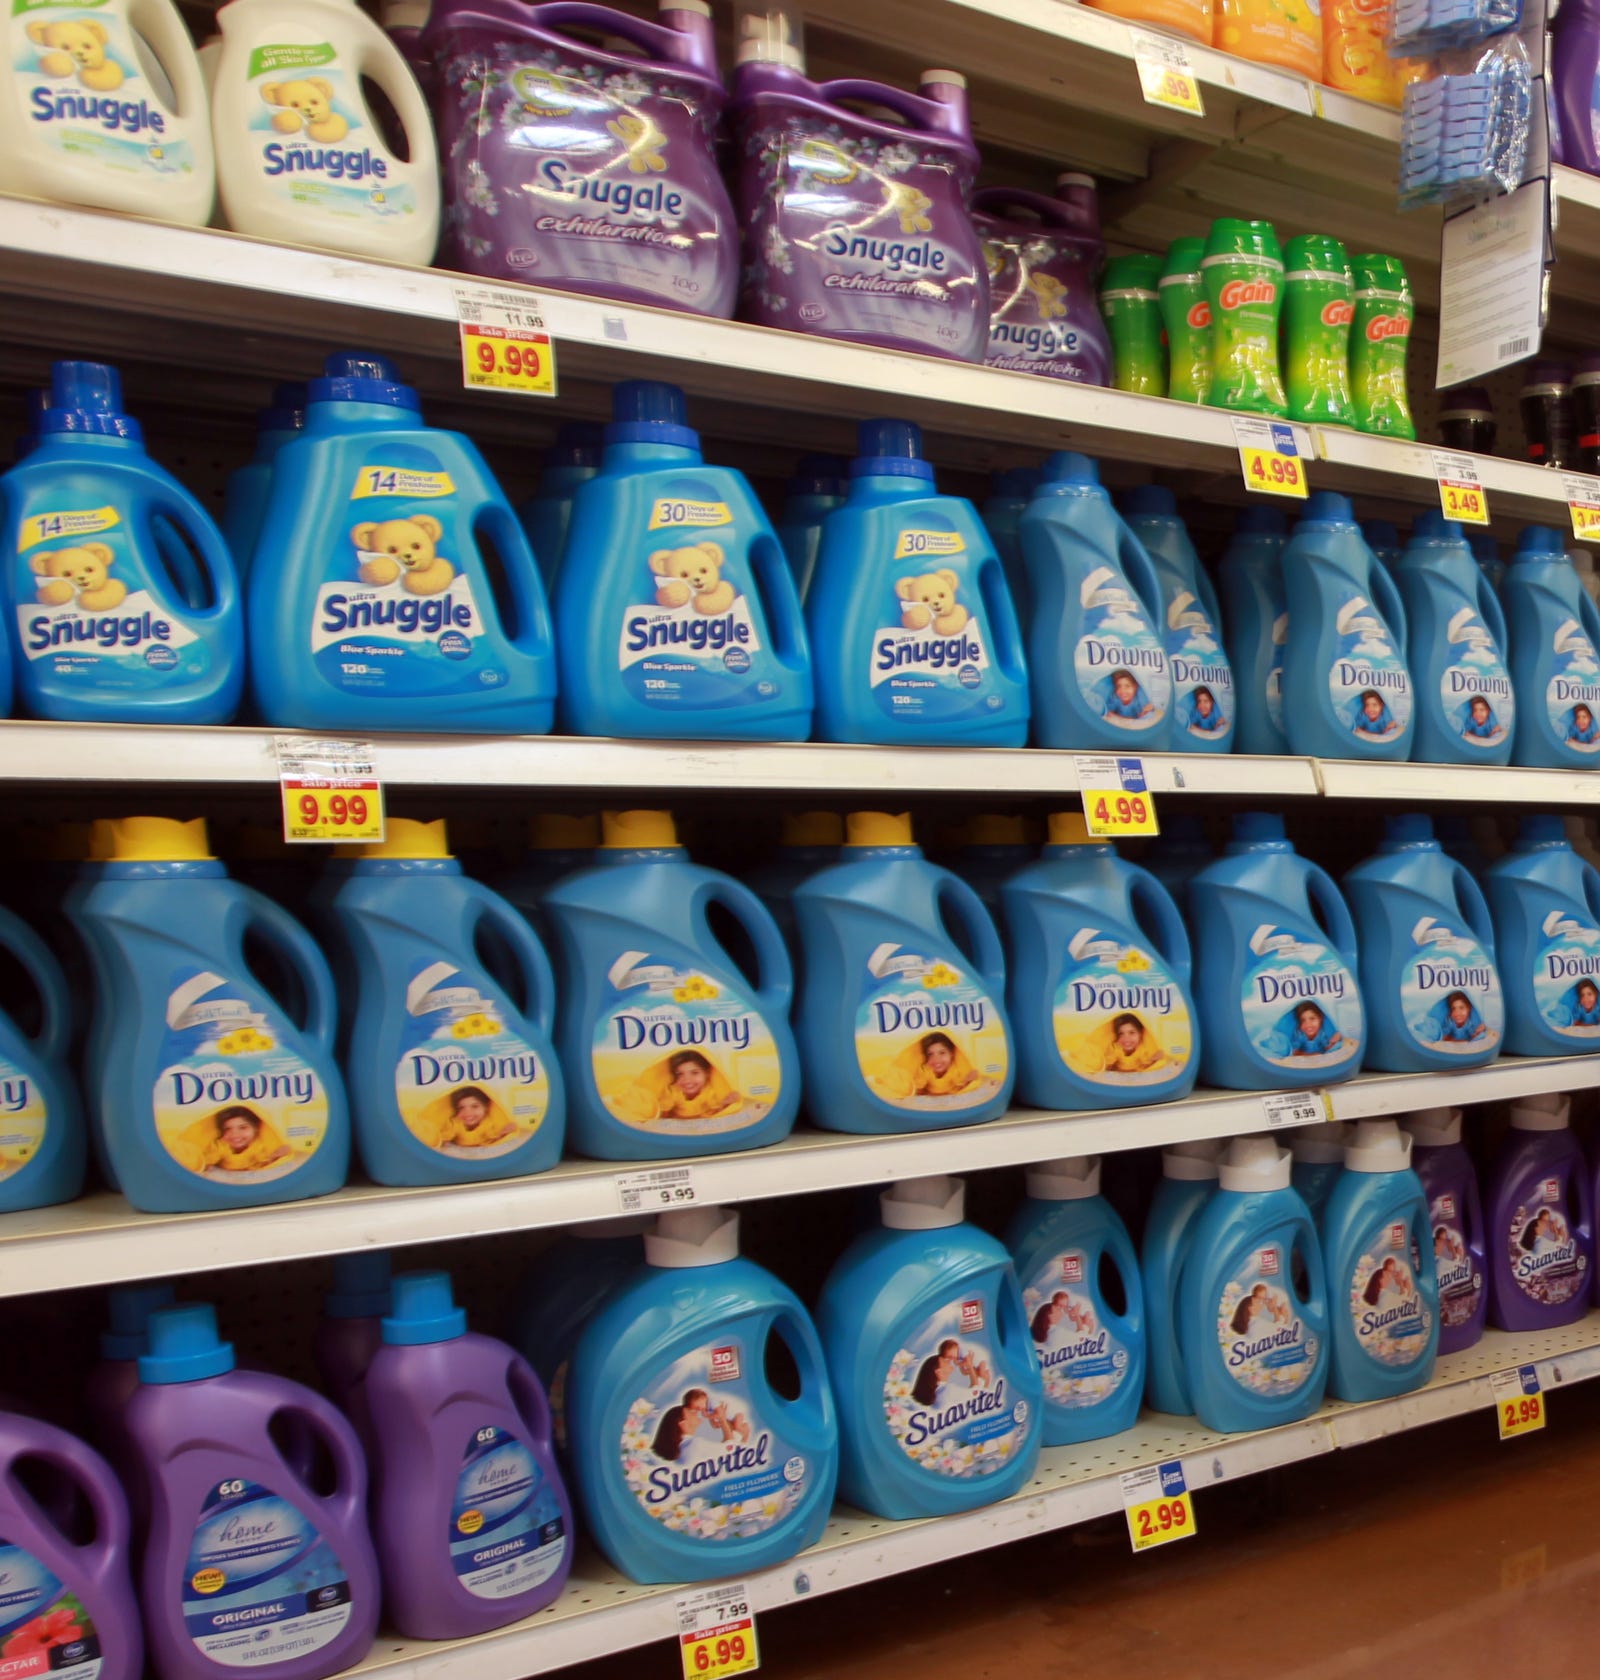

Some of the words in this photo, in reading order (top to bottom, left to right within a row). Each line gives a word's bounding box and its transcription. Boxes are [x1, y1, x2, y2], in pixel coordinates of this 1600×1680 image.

[31, 86, 164, 133] Snuggle
[263, 142, 387, 180] Snuggle
[542, 160, 682, 215] Snuggle
[826, 222, 945, 272] Snuggle
[1219, 279, 1276, 310] Gain
[1366, 314, 1411, 342] Gain
[477, 342, 540, 378] 9.99
[369, 471, 397, 493] 14
[1252, 456, 1298, 485] 4.99
[659, 503, 686, 523] 30
[1448, 490, 1479, 513] 3.49
[37, 517, 62, 538] 14
[904, 534, 926, 551] 30
[322, 594, 472, 633] Snuggle
[29, 611, 170, 651] Snuggle
[627, 613, 749, 651] Snuggle
[877, 635, 980, 670] Snuggle
[1085, 640, 1164, 673] Downy
[1172, 659, 1231, 689] Downy
[1340, 663, 1406, 694] Downy
[1450, 671, 1509, 699] Downy
[299, 794, 367, 826] 9.99
[1095, 797, 1147, 824] 4.99
[1256, 973, 1344, 1003] Downy
[1416, 963, 1490, 991] Downy
[1072, 982, 1171, 1014] Downy
[872, 1001, 984, 1033] Downy
[613, 1015, 751, 1050] Downy
[413, 1054, 536, 1086] Downy
[171, 1072, 314, 1105] Downy
[1293, 1107, 1316, 1120] 9.99
[661, 1187, 694, 1203] 9.99
[1436, 1262, 1469, 1288] uavitel
[1518, 1243, 1574, 1277] Suavitel
[1359, 1295, 1418, 1336] Suavitel
[713, 1353, 732, 1364] 30
[1228, 1321, 1298, 1366] Suavitel
[905, 1379, 1003, 1445] Suavitel
[1505, 1398, 1539, 1427] 2.99
[476, 1428, 495, 1442] 60
[478, 1459, 517, 1485] home
[645, 1433, 768, 1503] Suavitel
[219, 1479, 245, 1495] 60
[219, 1515, 275, 1542] home
[1137, 1500, 1186, 1537] 2.99
[473, 1538, 526, 1562] ORIGINAL
[212, 1602, 287, 1626] ORIGINAL
[717, 1602, 748, 1620] 7.99
[0, 1656, 39, 1672] CTAR
[694, 1635, 745, 1671] 6.99
